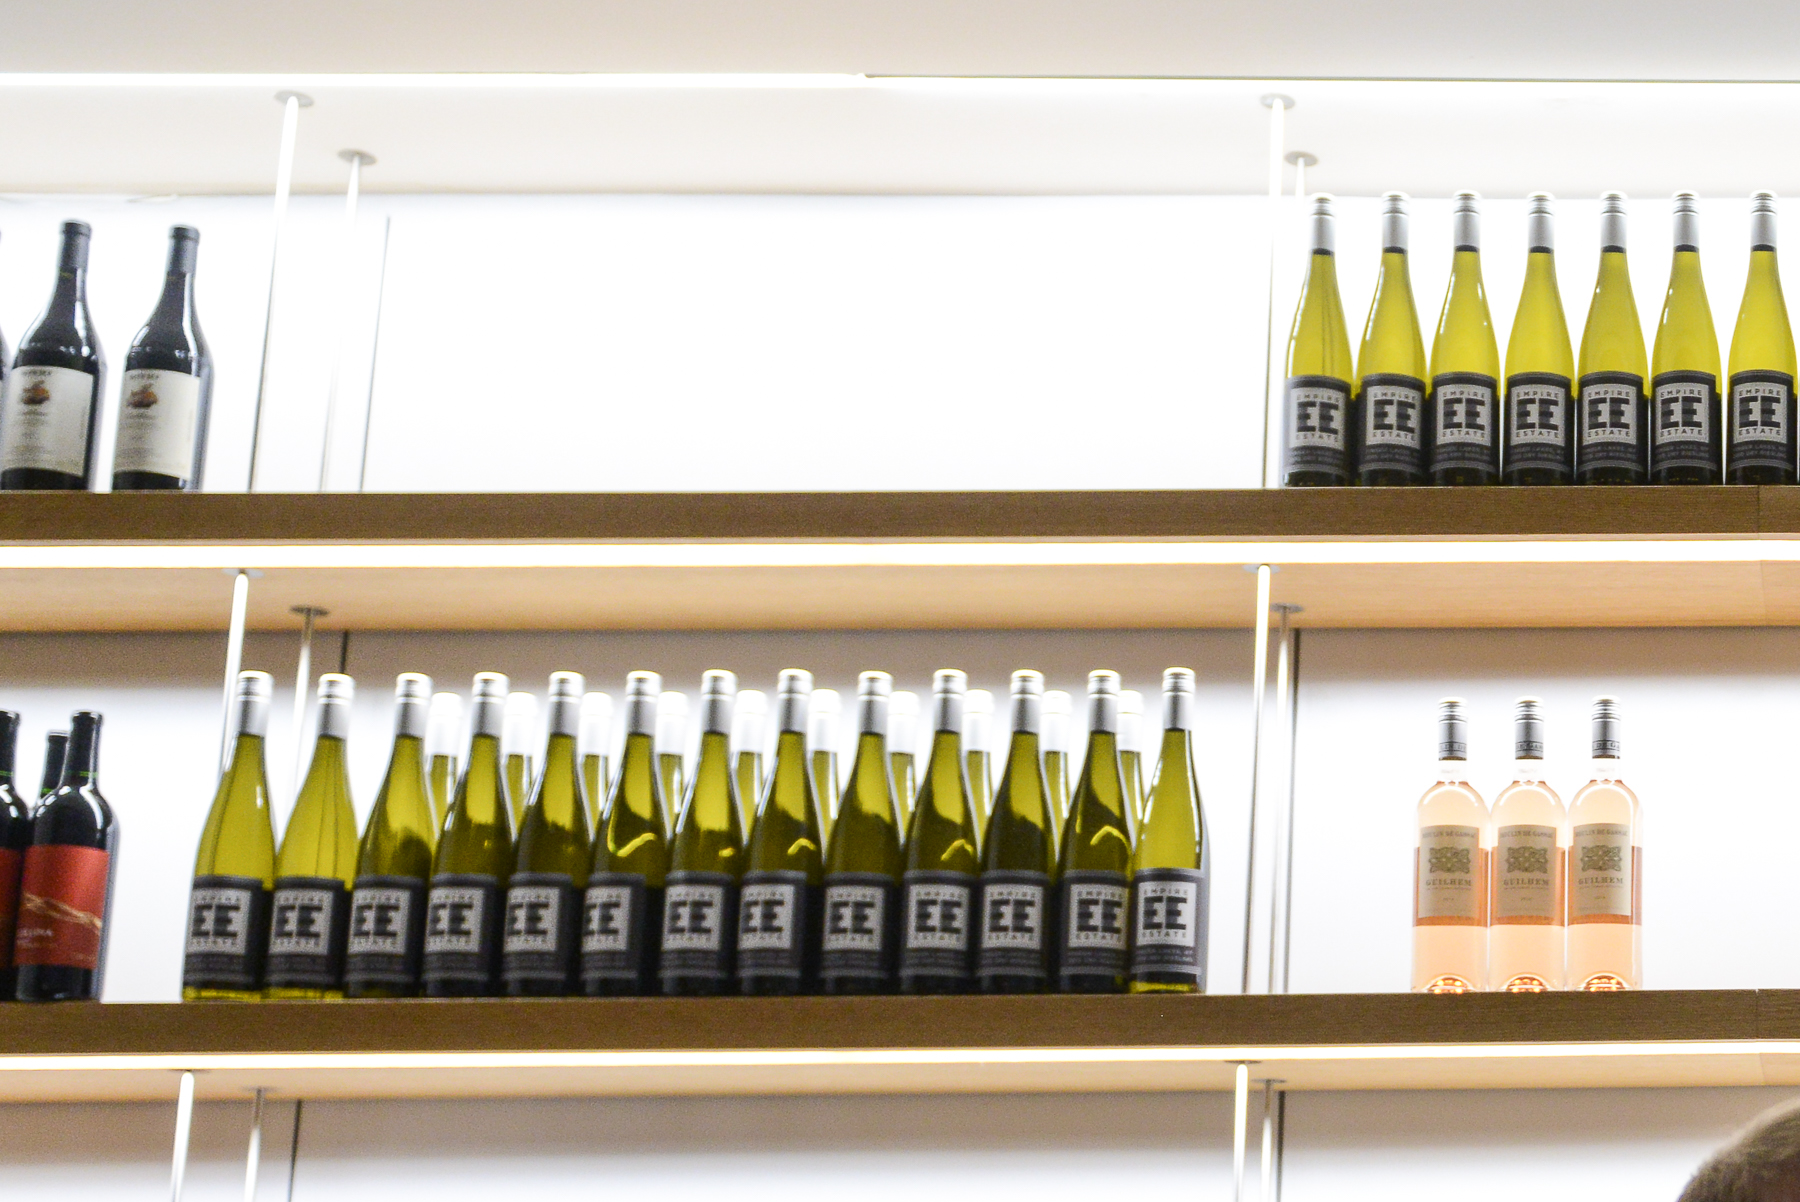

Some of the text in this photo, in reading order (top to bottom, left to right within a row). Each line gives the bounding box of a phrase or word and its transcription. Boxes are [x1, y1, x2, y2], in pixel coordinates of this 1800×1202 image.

[1516, 391, 1558, 399] EMPIRE
[1588, 390, 1630, 398] EMPIRE
[1661, 389, 1702, 397] EMPIRE
[1739, 389, 1781, 397] EMPIRE
[1516, 430, 1558, 439] ESTATE
[1588, 429, 1630, 438] ESTATE
[1660, 428, 1702, 437] ESTATE
[1739, 428, 1781, 436] ESTATE
[1144, 888, 1188, 897] EMPIRE
[1142, 930, 1187, 938] ESTATE
